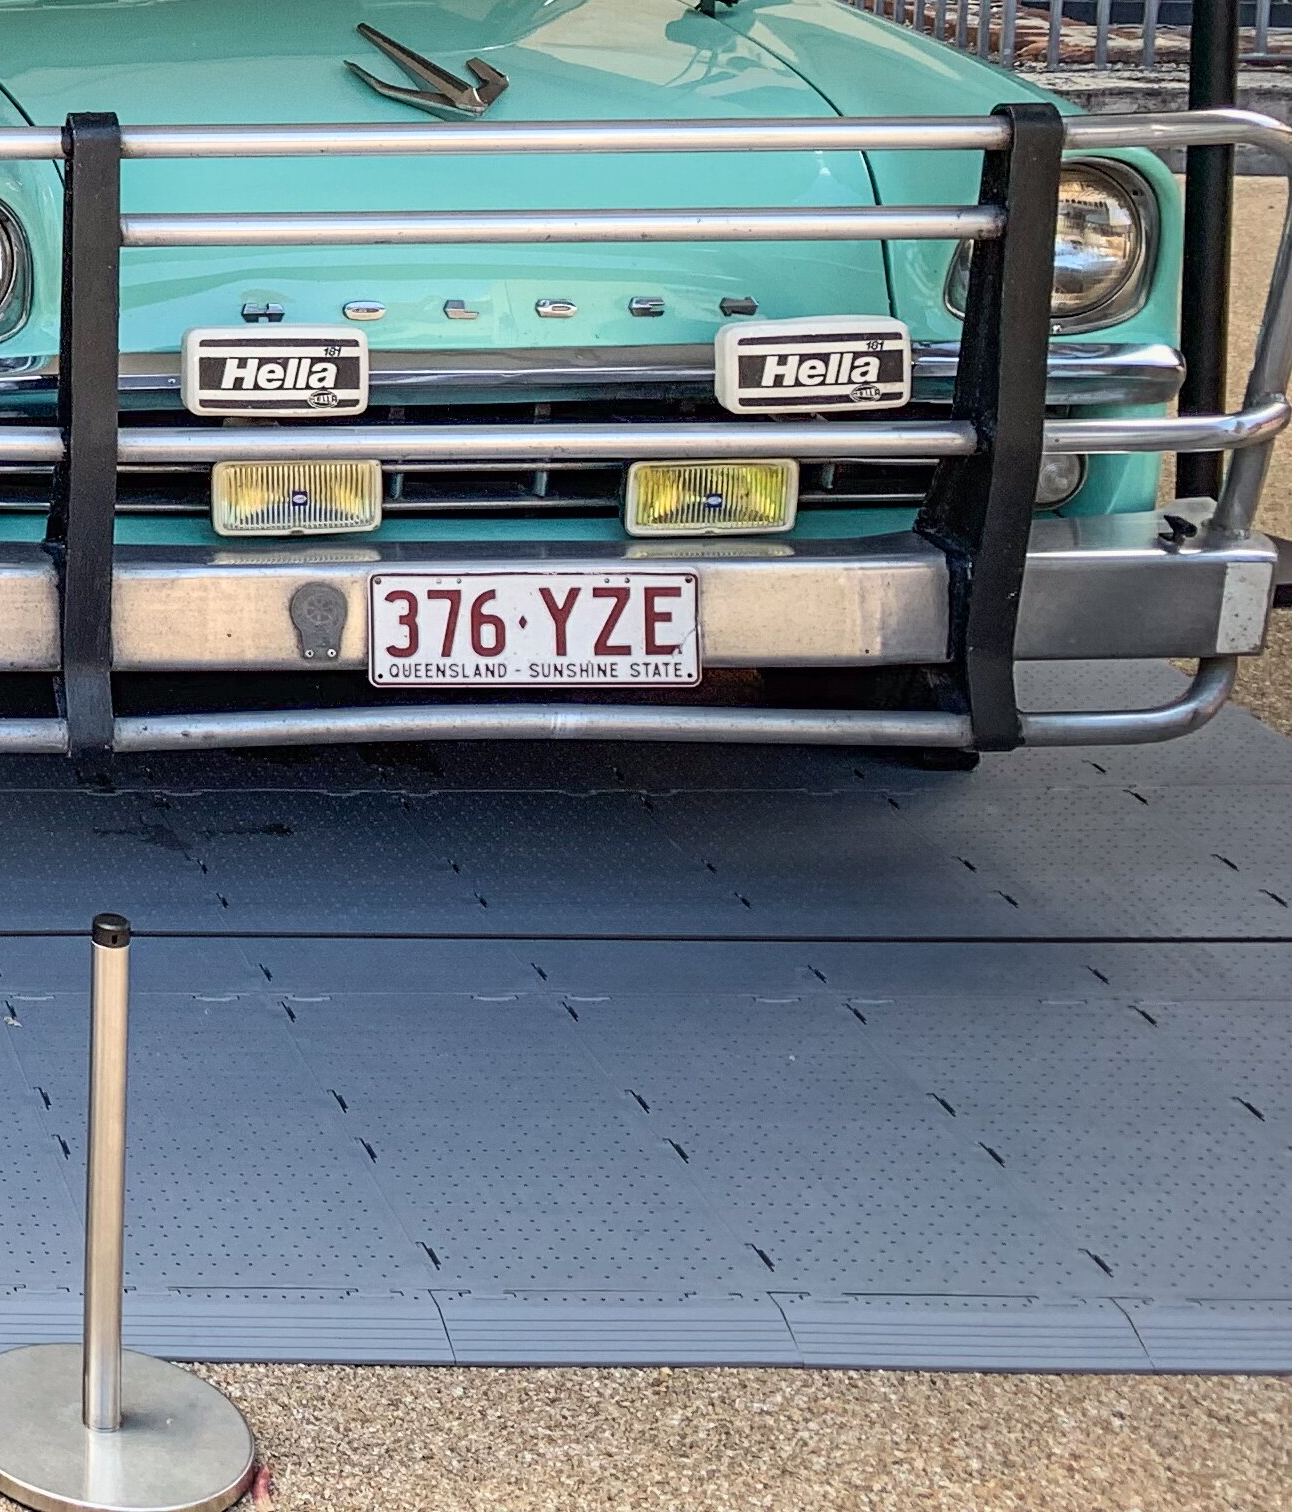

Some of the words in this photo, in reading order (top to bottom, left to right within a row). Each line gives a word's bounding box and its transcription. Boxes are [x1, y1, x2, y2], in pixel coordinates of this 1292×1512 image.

[241, 296, 759, 323] HOLDEN
[220, 358, 337, 389] Hella
[761, 353, 881, 387] Hella
[388, 664, 507, 679] QUEENSLAND
[529, 662, 618, 678] SUNSHINE
[630, 663, 683, 678] STATE
